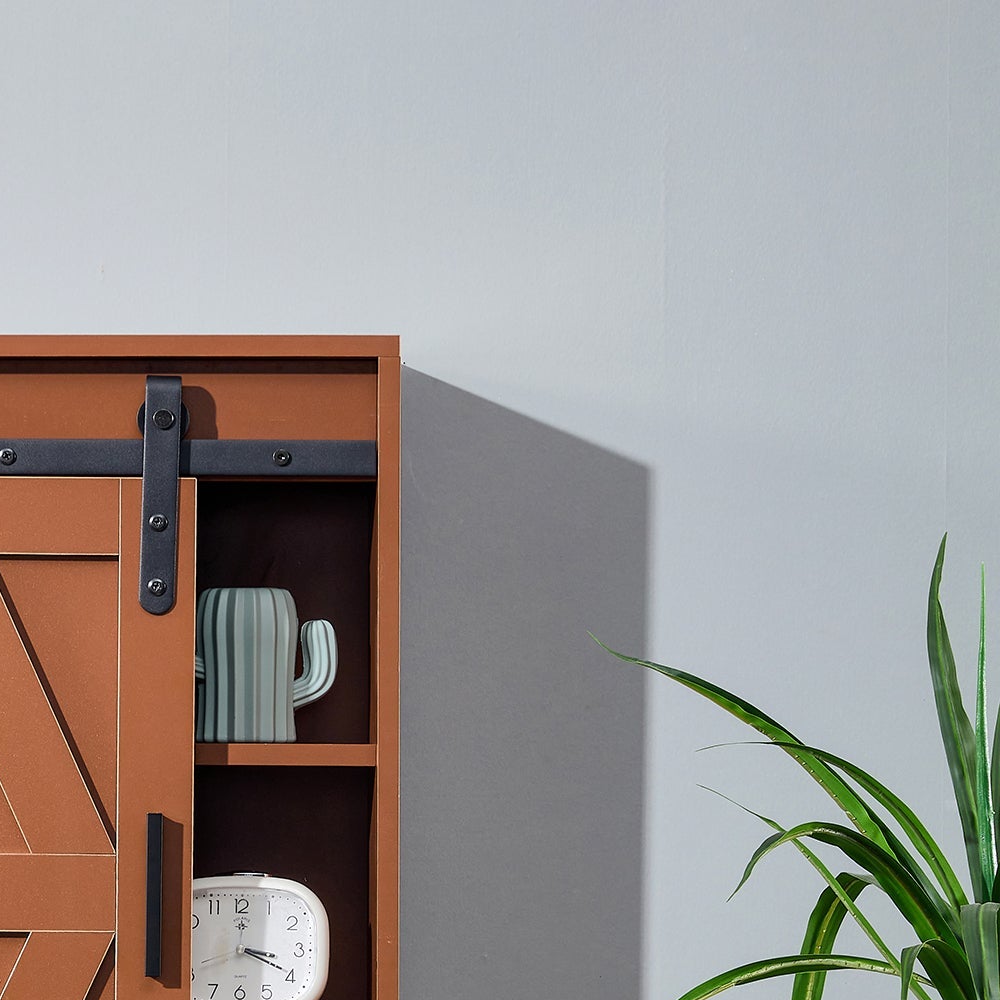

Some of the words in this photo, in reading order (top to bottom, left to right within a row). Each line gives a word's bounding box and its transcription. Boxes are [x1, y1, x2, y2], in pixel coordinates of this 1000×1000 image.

[208, 899, 220, 915] 11
[234, 898, 249, 914] 12
[266, 900, 271, 915] 1
[286, 915, 299, 931] 2
[293, 942, 305, 958] 3
[284, 968, 297, 984] 4
[207, 983, 219, 1000] 7
[234, 984, 246, 1000] 6
[261, 984, 273, 1000] 5
